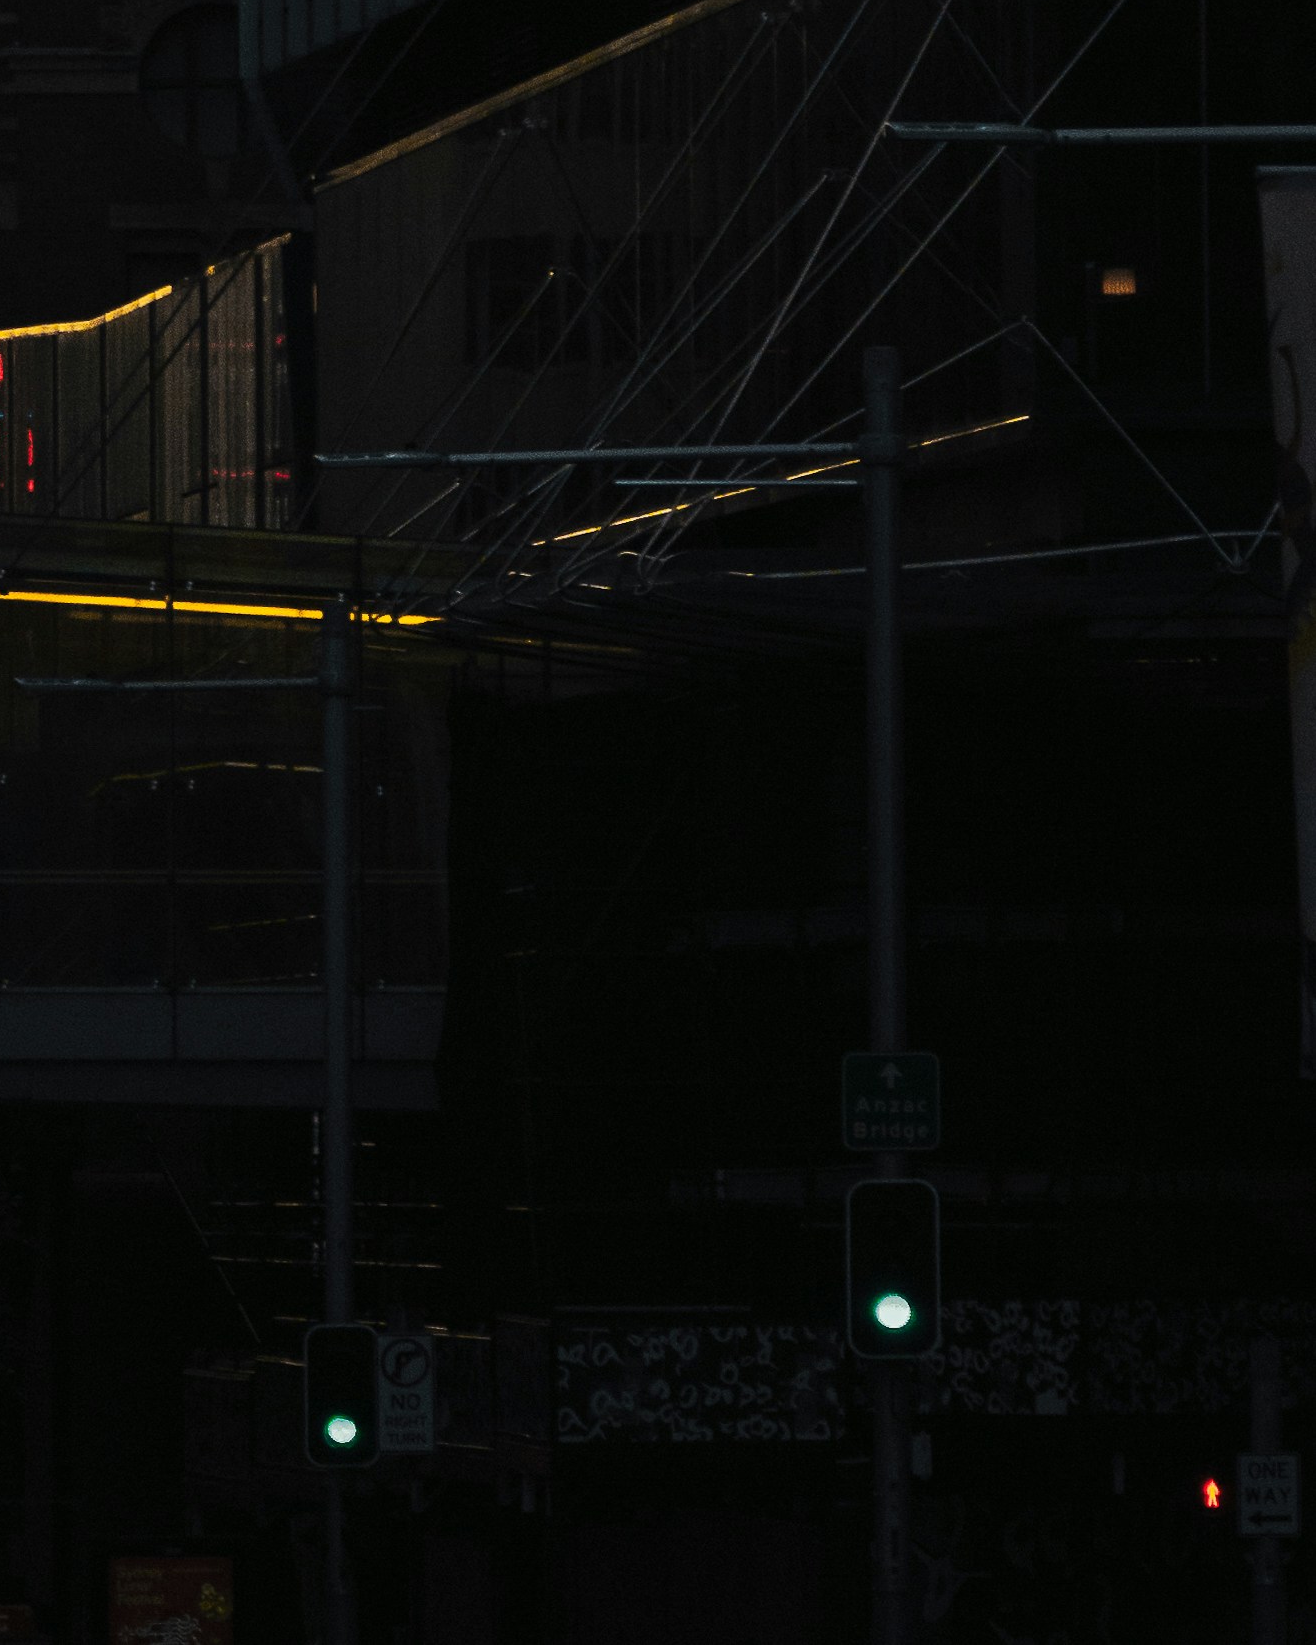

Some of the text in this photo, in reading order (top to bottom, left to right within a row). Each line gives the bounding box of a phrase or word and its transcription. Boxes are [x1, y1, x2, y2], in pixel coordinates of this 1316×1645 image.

[854, 1096, 927, 1114] Anzac
[852, 1120, 929, 1143] Bridge
[390, 1393, 421, 1410] NO
[387, 1432, 427, 1444] TURN
[1248, 1461, 1290, 1479] ONE
[1245, 1486, 1292, 1504] WAY
